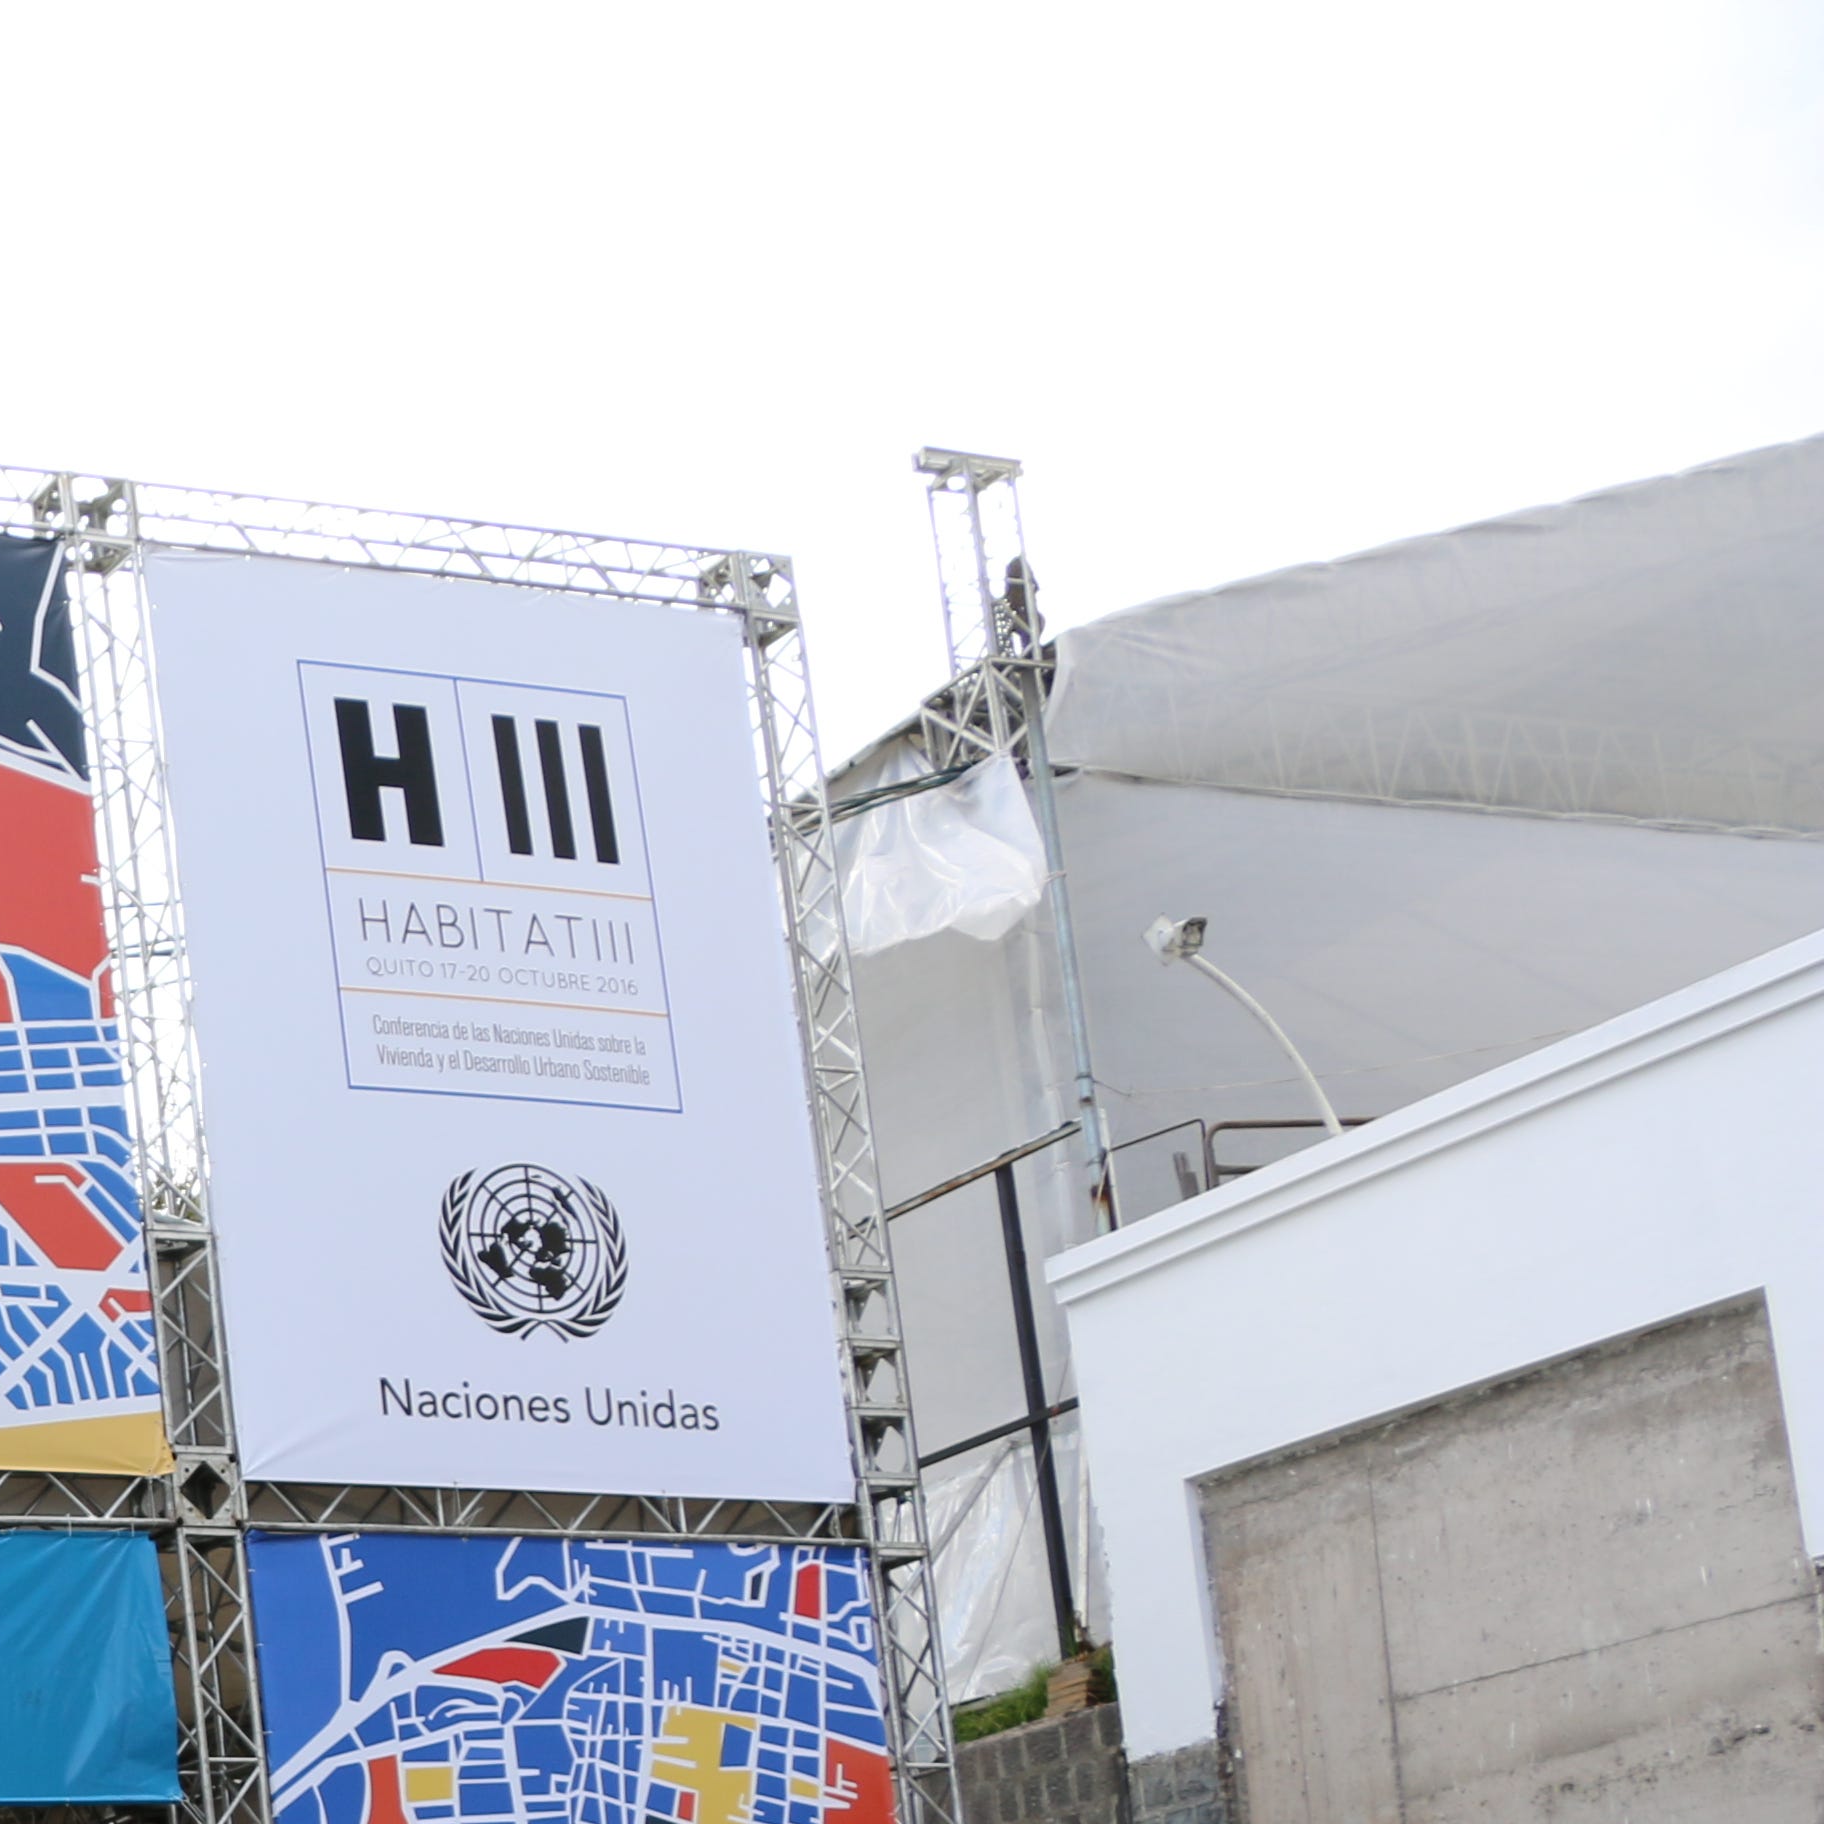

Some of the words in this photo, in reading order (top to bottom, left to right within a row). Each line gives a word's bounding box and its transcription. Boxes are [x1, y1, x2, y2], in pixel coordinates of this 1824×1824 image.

[334, 697, 444, 847] H
[491, 713, 620, 865] III
[366, 956, 434, 977] QUITO
[441, 962, 490, 983] 17-20
[499, 967, 591, 992] OCTUBRE
[597, 976, 639, 996] 2016
[372, 1014, 450, 1040] Conferencia
[453, 1022, 468, 1041] de
[472, 1023, 491, 1042] las
[493, 1024, 550, 1047] Naciones
[553, 1029, 595, 1051] Unidas
[598, 1034, 634, 1055] sobre
[636, 1036, 647, 1056] la
[376, 1044, 434, 1068] Vivienda
[448, 1049, 460, 1070] el
[464, 1050, 531, 1075] Desarrollo
[534, 1057, 581, 1080] Urbano
[584, 1061, 651, 1086] Sostenible
[378, 1377, 571, 1425] Naciones
[585, 1388, 720, 1432] Unidas
